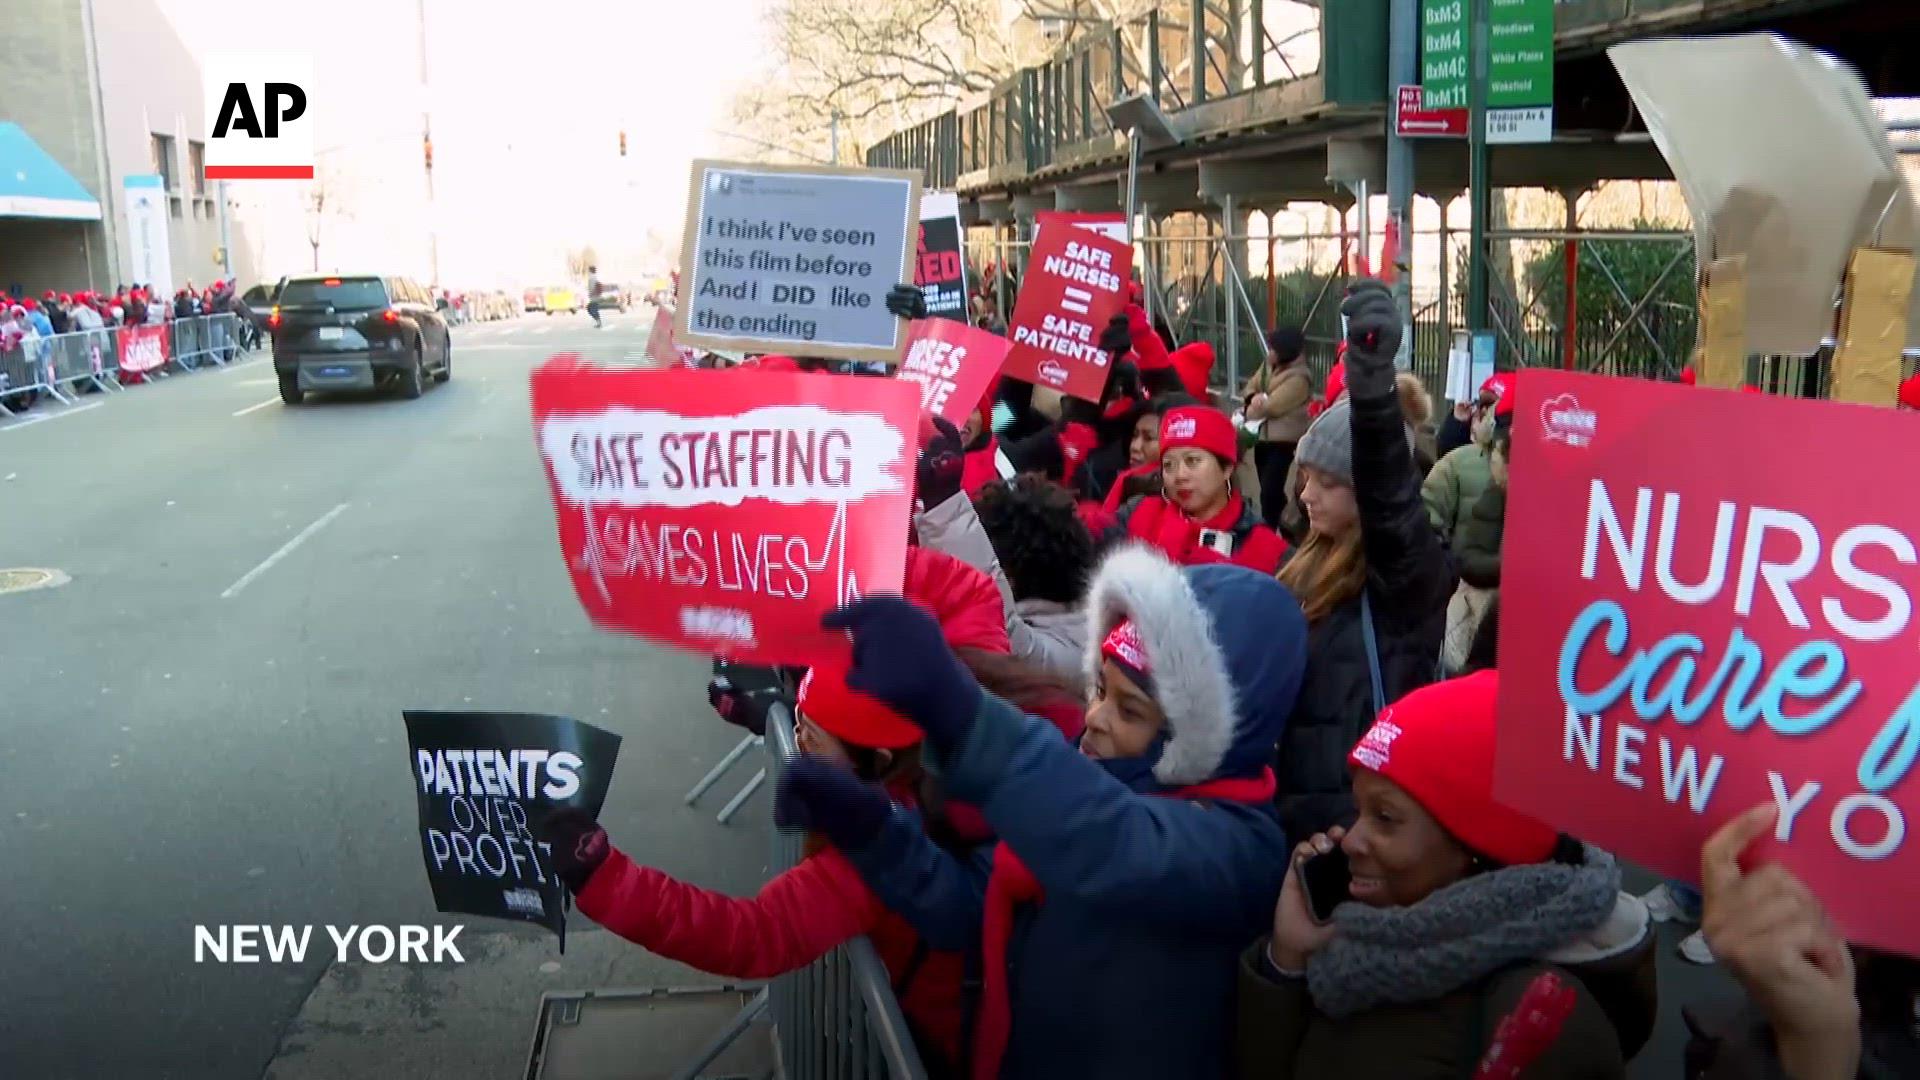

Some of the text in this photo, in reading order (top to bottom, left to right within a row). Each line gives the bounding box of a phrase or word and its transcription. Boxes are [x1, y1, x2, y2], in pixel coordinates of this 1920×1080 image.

[1426, 1, 1461, 24] BxM3
[1426, 29, 1461, 52] BxM4
[1492, 23, 1535, 36] Woodlawn
[1426, 56, 1466, 80] BxM4C
[1492, 51, 1544, 64] White Plains
[1402, 90, 1414, 101] NO
[1426, 84, 1467, 107] BxM11
[1492, 79, 1532, 93] Wakefield
[705, 216, 875, 247] I think I've seen
[704, 248, 872, 277] this film before
[1064, 241, 1112, 270] SAFE
[1043, 255, 1120, 293] NURSES
[700, 277, 871, 308] And I DID like
[697, 308, 817, 340] the ending
[1042, 314, 1092, 341] SAFE
[1014, 326, 1108, 367] PATIENTS
[571, 428, 852, 489] SAFE STAFFING
[603, 515, 810, 600] SAVES LIVES
[1557, 599, 1864, 735] Care
[1562, 703, 1724, 814] NEW
[417, 748, 584, 800] PATIENTS
[451, 794, 533, 842] OVER
